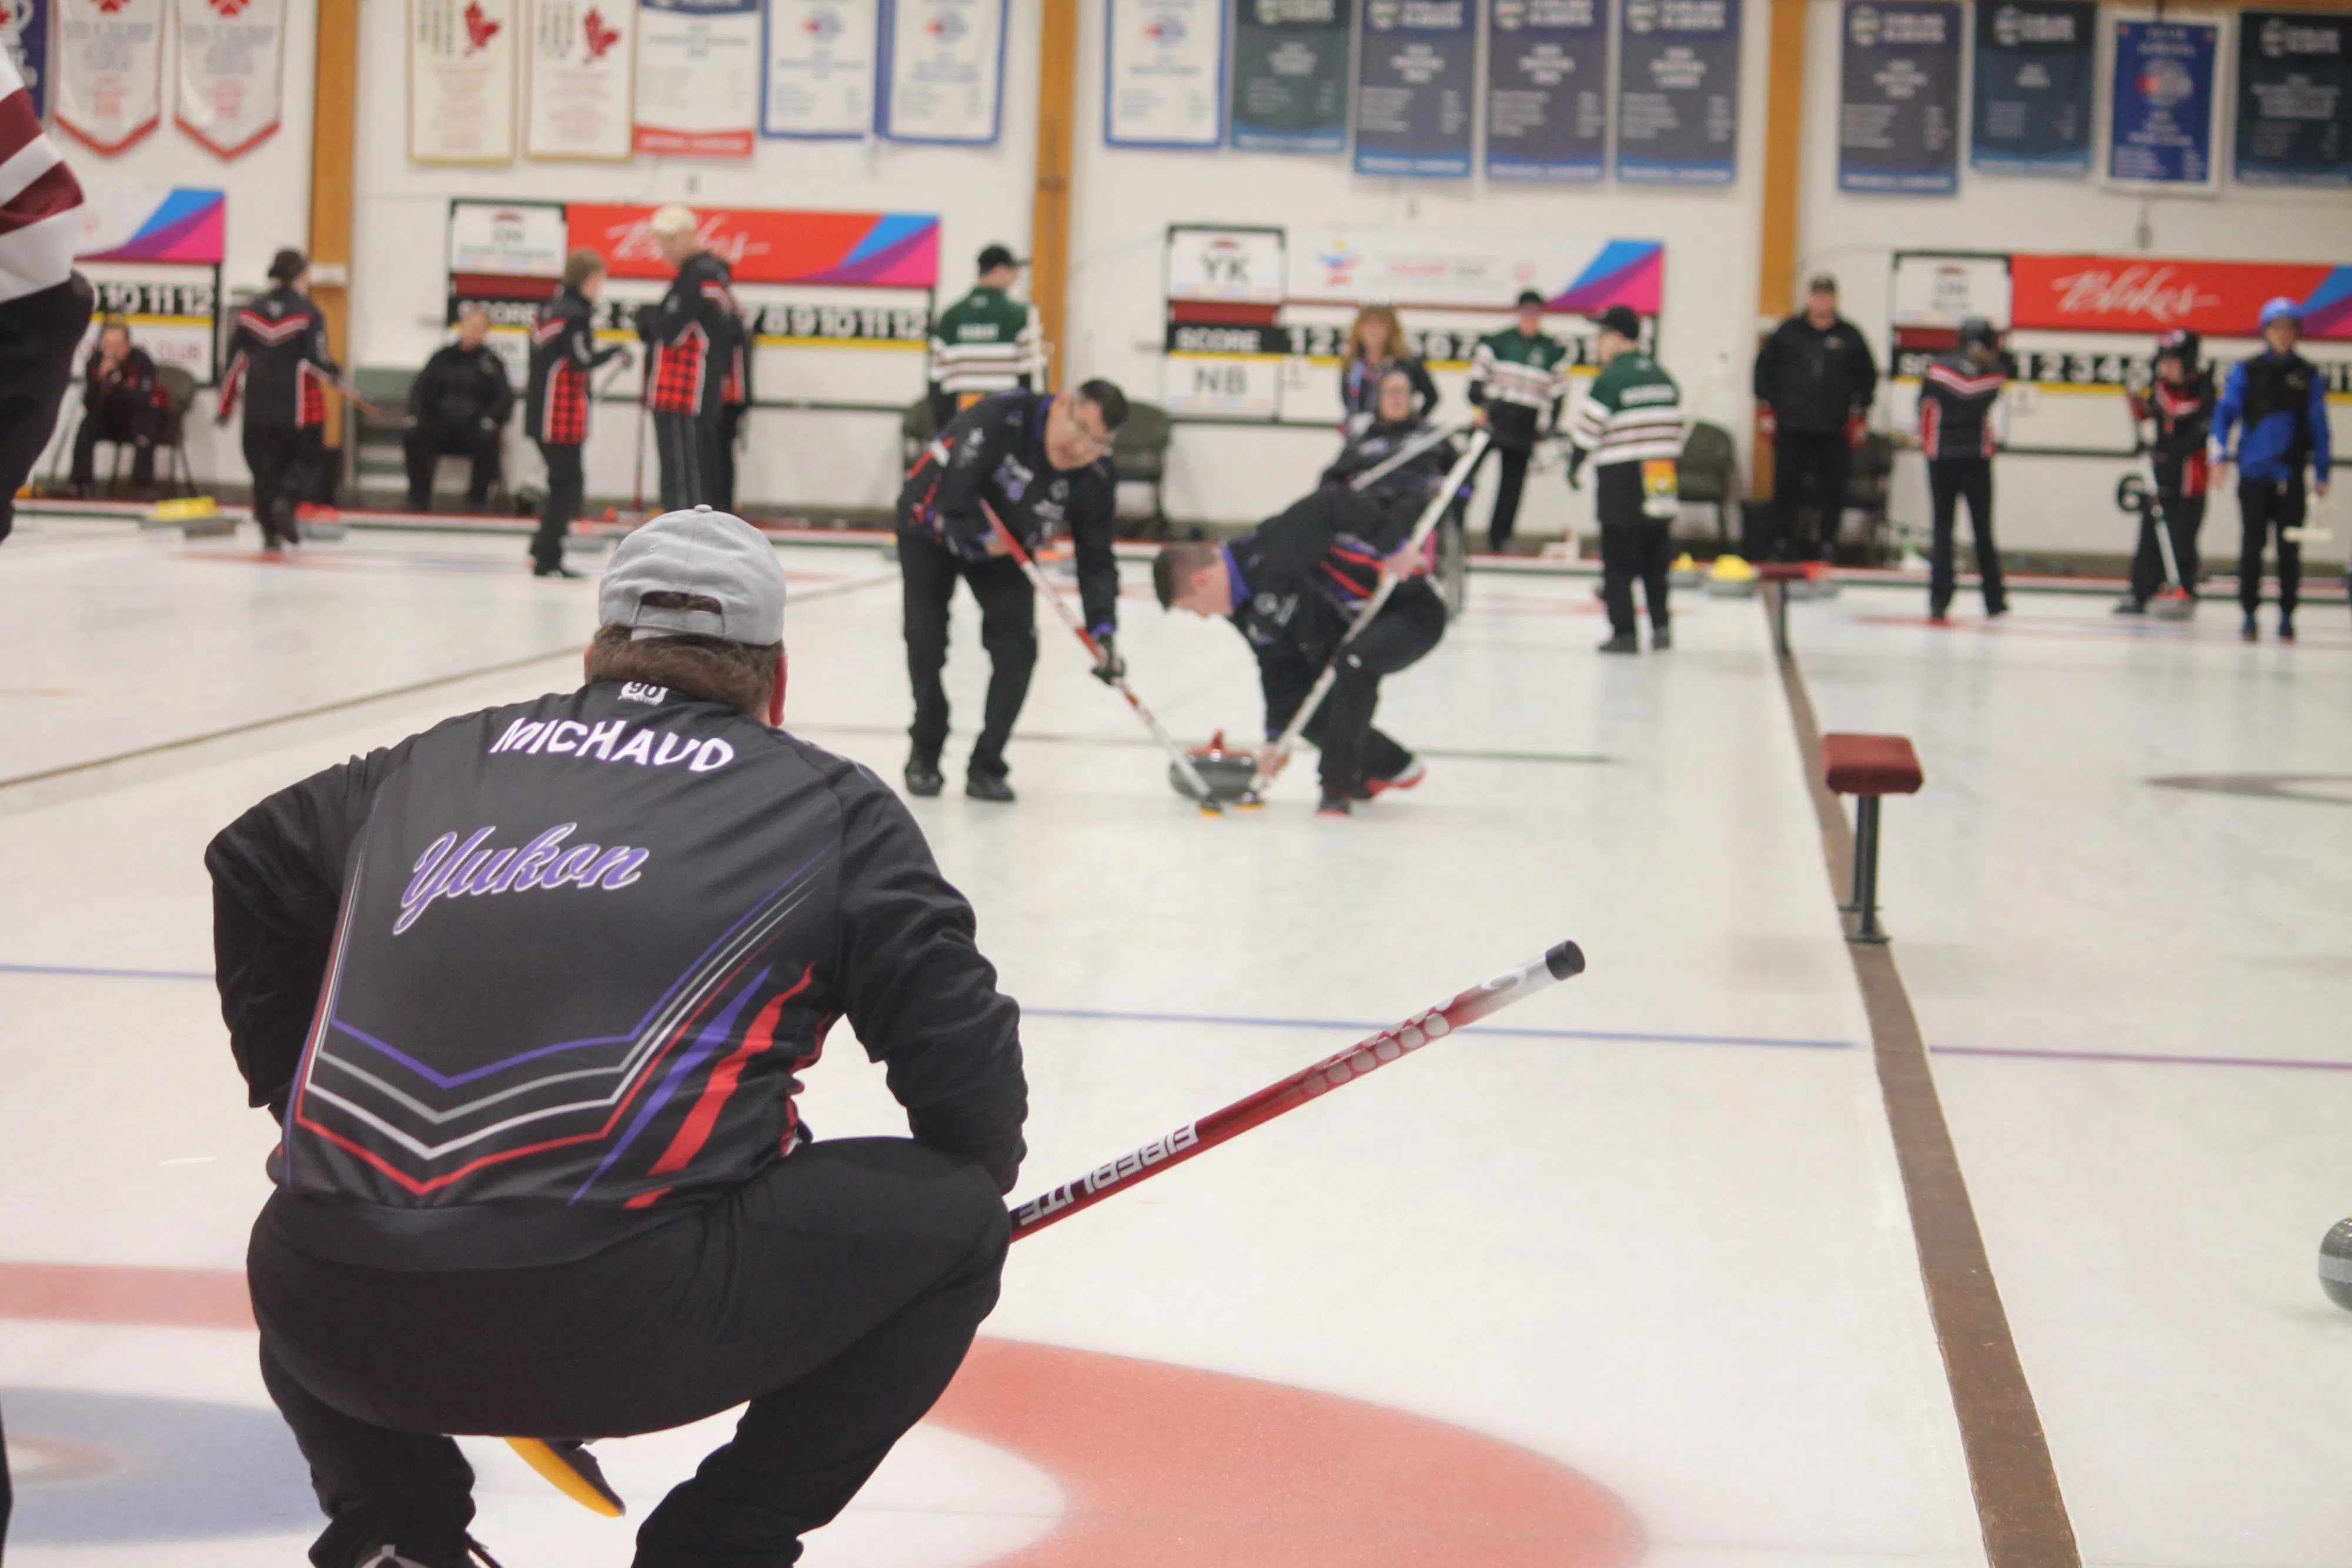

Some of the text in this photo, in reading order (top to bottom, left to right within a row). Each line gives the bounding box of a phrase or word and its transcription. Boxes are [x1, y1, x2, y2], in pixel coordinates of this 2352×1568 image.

[1201, 254, 1250, 281] YK
[104, 282, 213, 317] 10 11 12
[818, 309, 856, 338] 10
[858, 310, 889, 339] 11
[1177, 326, 1262, 353] SCORE
[1194, 366, 1247, 397] NB
[489, 717, 736, 772] MICHAUD
[393, 822, 650, 935] Yukon
[1018, 1121, 1200, 1226] FIBERLITE
